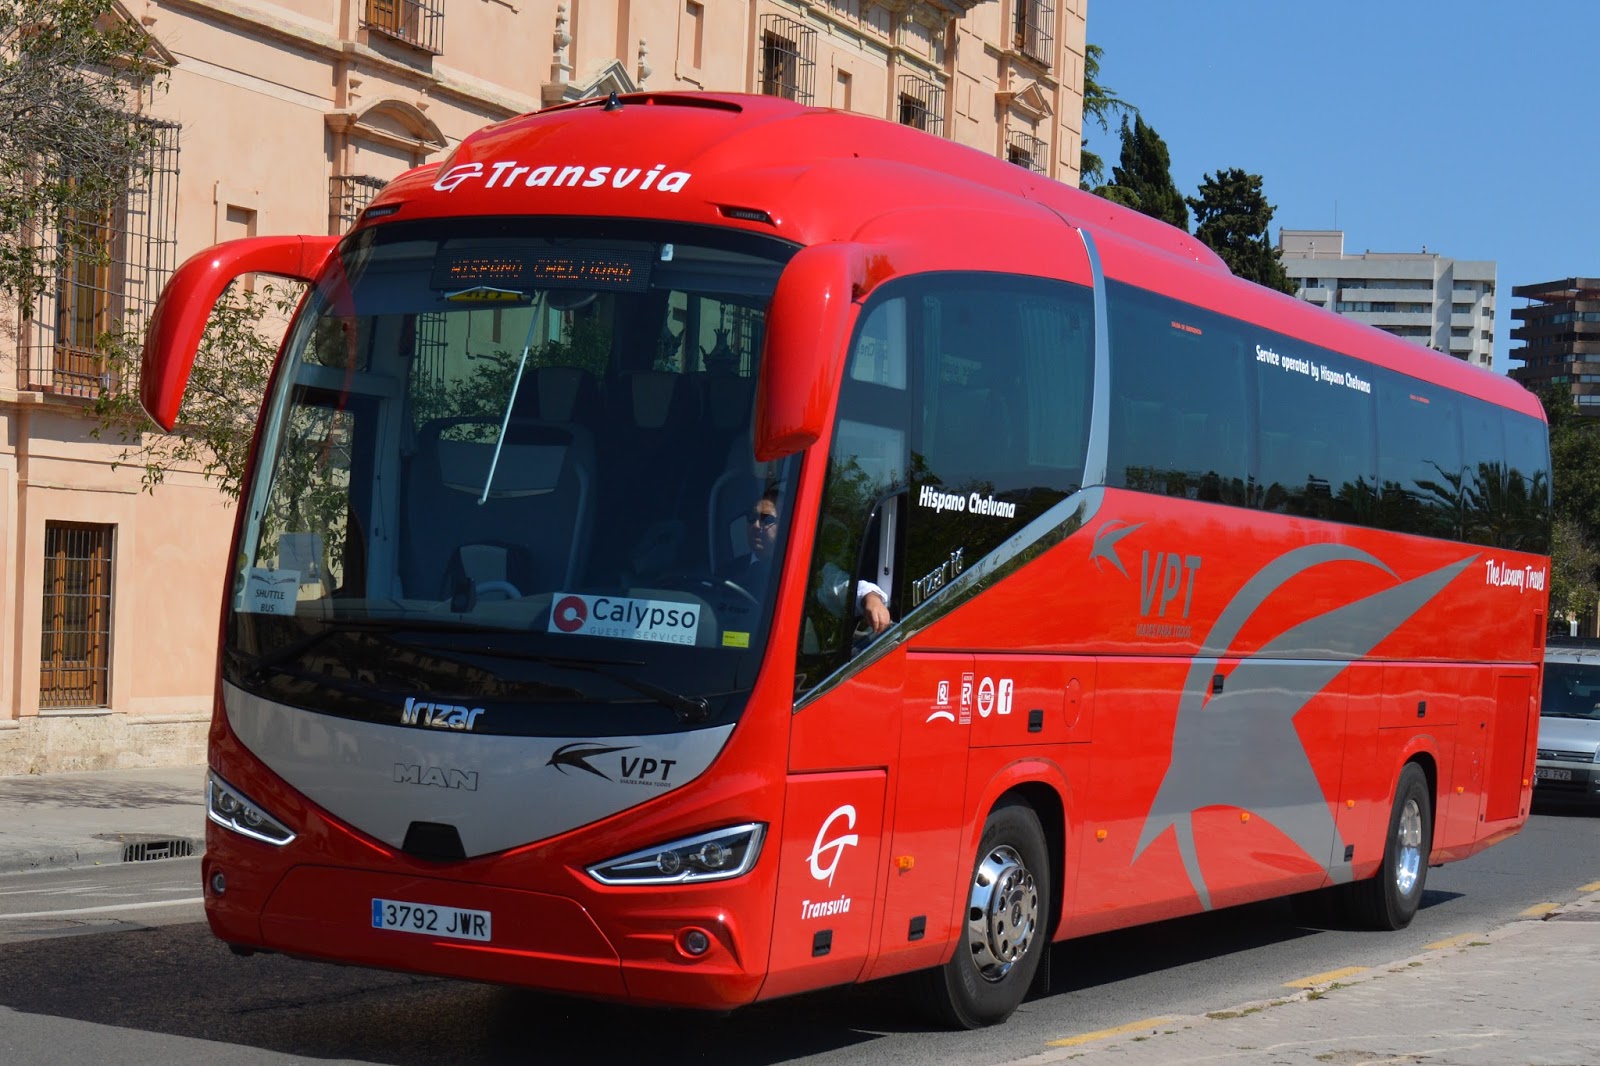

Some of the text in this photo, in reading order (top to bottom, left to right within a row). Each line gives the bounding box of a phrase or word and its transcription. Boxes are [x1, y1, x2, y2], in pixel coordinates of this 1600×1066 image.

[484, 160, 692, 193] Transvia
[1255, 344, 1371, 394] Service operated by Hispano Chelvana
[919, 485, 1016, 519] Hispano Chelvana
[1140, 549, 1202, 619] VPT
[1485, 559, 1500, 587] The
[1525, 565, 1546, 592] Travel
[255, 588, 286, 600] SHUTTLE
[260, 603, 275, 613] BUS
[592, 598, 696, 629] Calypso
[589, 626, 694, 644] GUEST SERVICES
[400, 697, 484, 731] Irizar
[393, 762, 479, 792] MAN
[621, 756, 677, 781] VPT
[386, 904, 485, 937] 3792 JWR
[801, 894, 851, 919] Transvia
